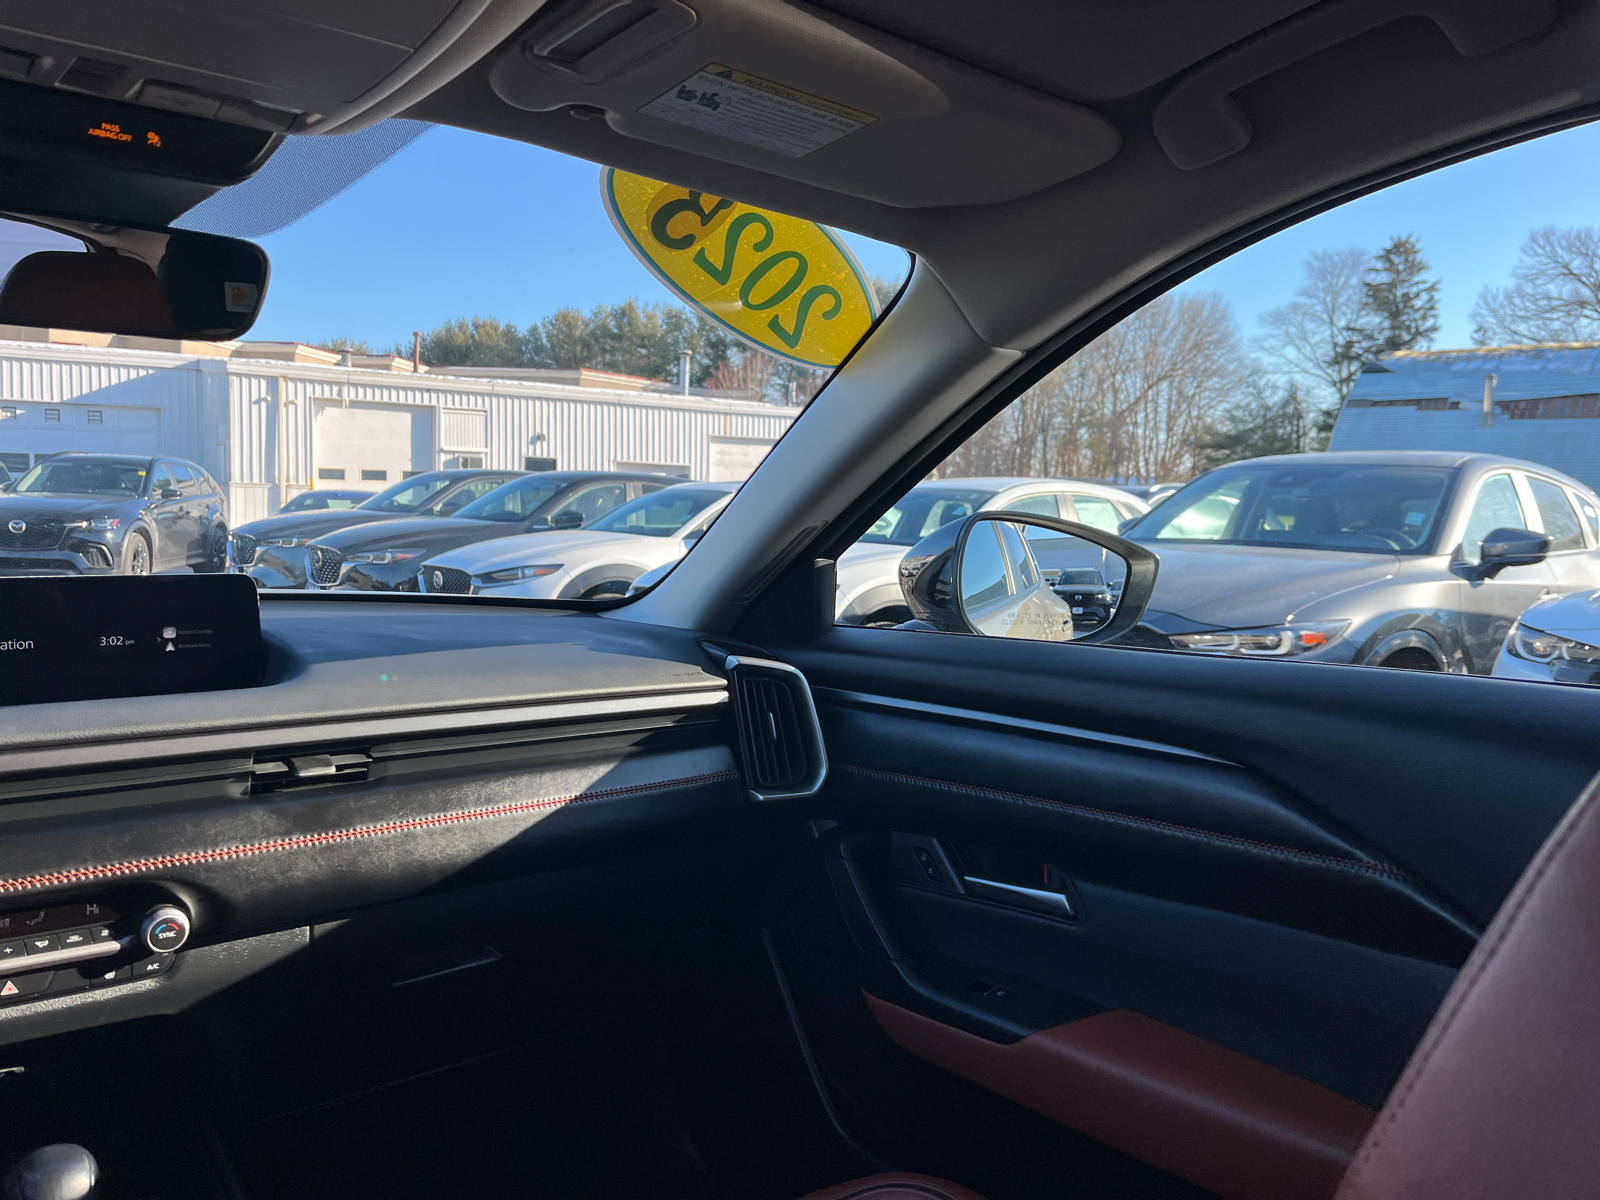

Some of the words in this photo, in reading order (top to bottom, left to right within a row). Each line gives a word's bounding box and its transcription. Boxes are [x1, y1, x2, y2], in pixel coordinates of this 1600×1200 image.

[743, 77, 802, 101] WARNING
[697, 75, 725, 87] EVEN
[727, 84, 752, 96] WITH
[753, 94, 810, 114] ADVANCED
[812, 111, 828, 120] AIR
[829, 115, 855, 129] BAGS
[102, 123, 119, 132] PASS
[100, 636, 124, 646] 3:02
[158, 930, 177, 939] SYNC
[146, 962, 160, 971] A/C
